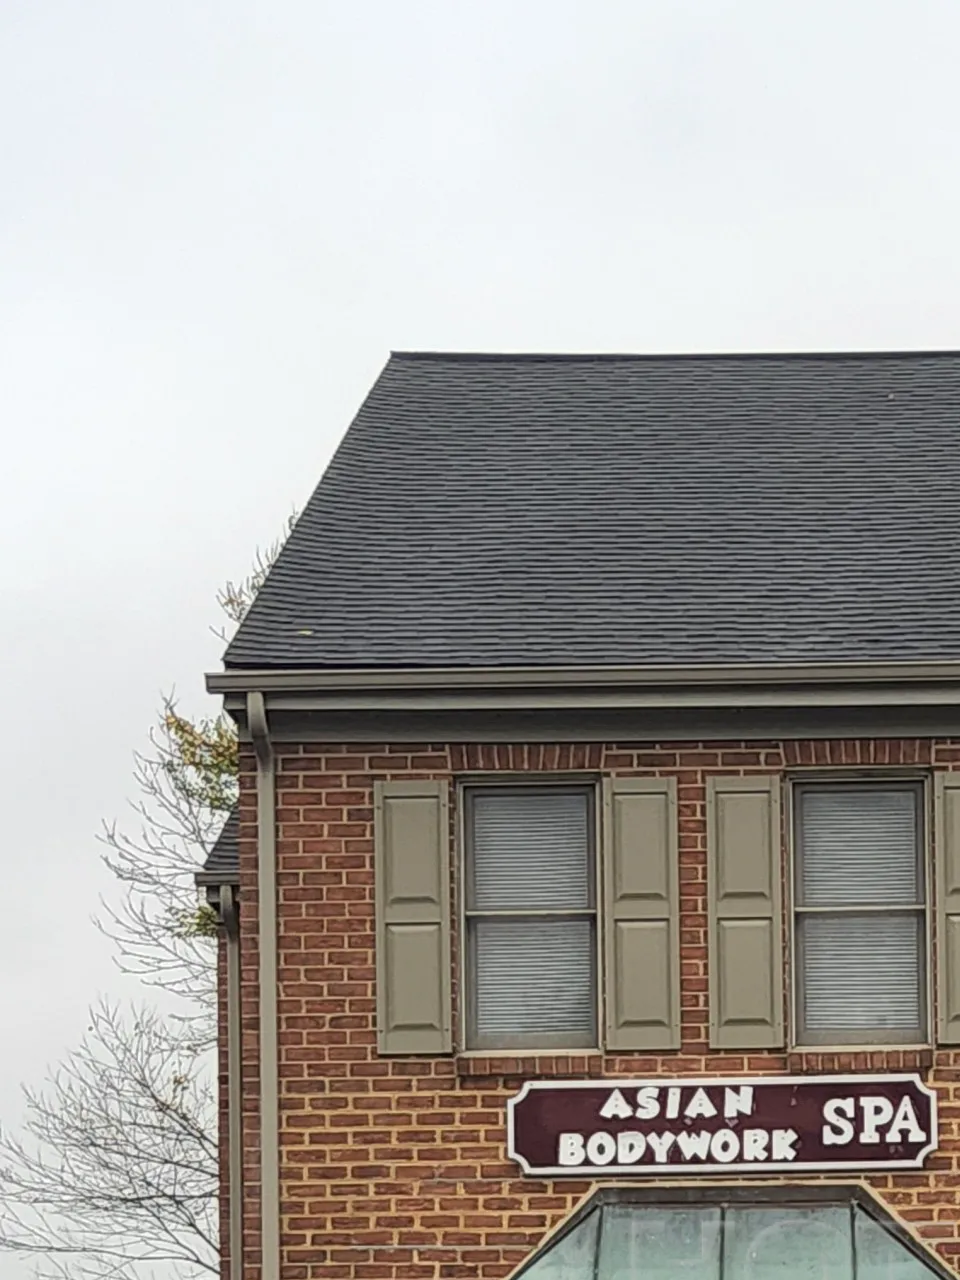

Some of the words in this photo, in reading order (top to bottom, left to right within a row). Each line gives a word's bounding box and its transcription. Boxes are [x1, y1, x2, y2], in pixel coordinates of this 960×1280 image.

[599, 1085, 755, 1120] ASIAN
[822, 1095, 927, 1145] SPA
[558, 1128, 799, 1166] BODYWORK
